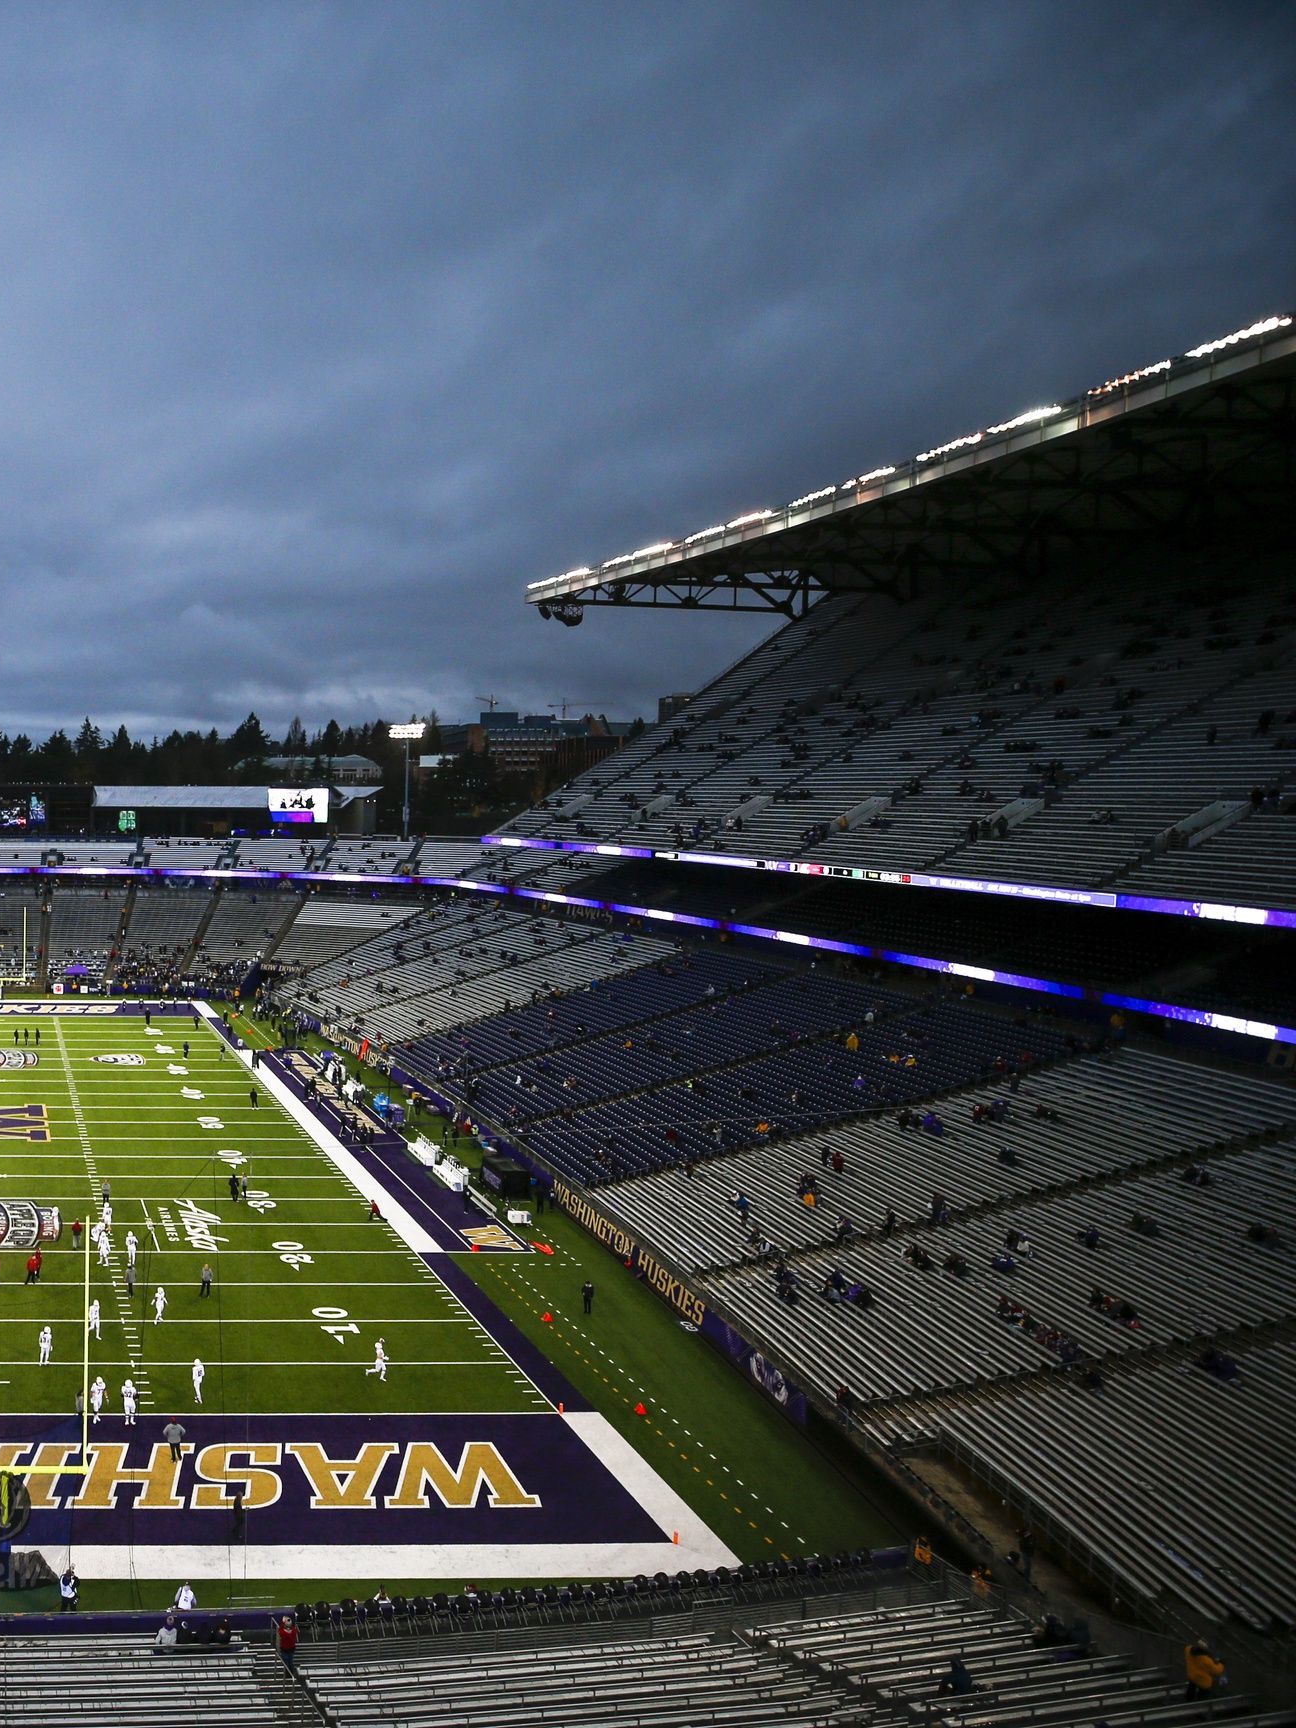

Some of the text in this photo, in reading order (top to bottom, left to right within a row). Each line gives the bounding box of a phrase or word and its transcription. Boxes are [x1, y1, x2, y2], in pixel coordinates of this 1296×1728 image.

[157, 1206, 180, 1242] AIRLINES
[271, 1240, 315, 1264] 20
[554, 1179, 706, 1326] WASHINGTON HUSKIES
[311, 1306, 361, 1335] 10
